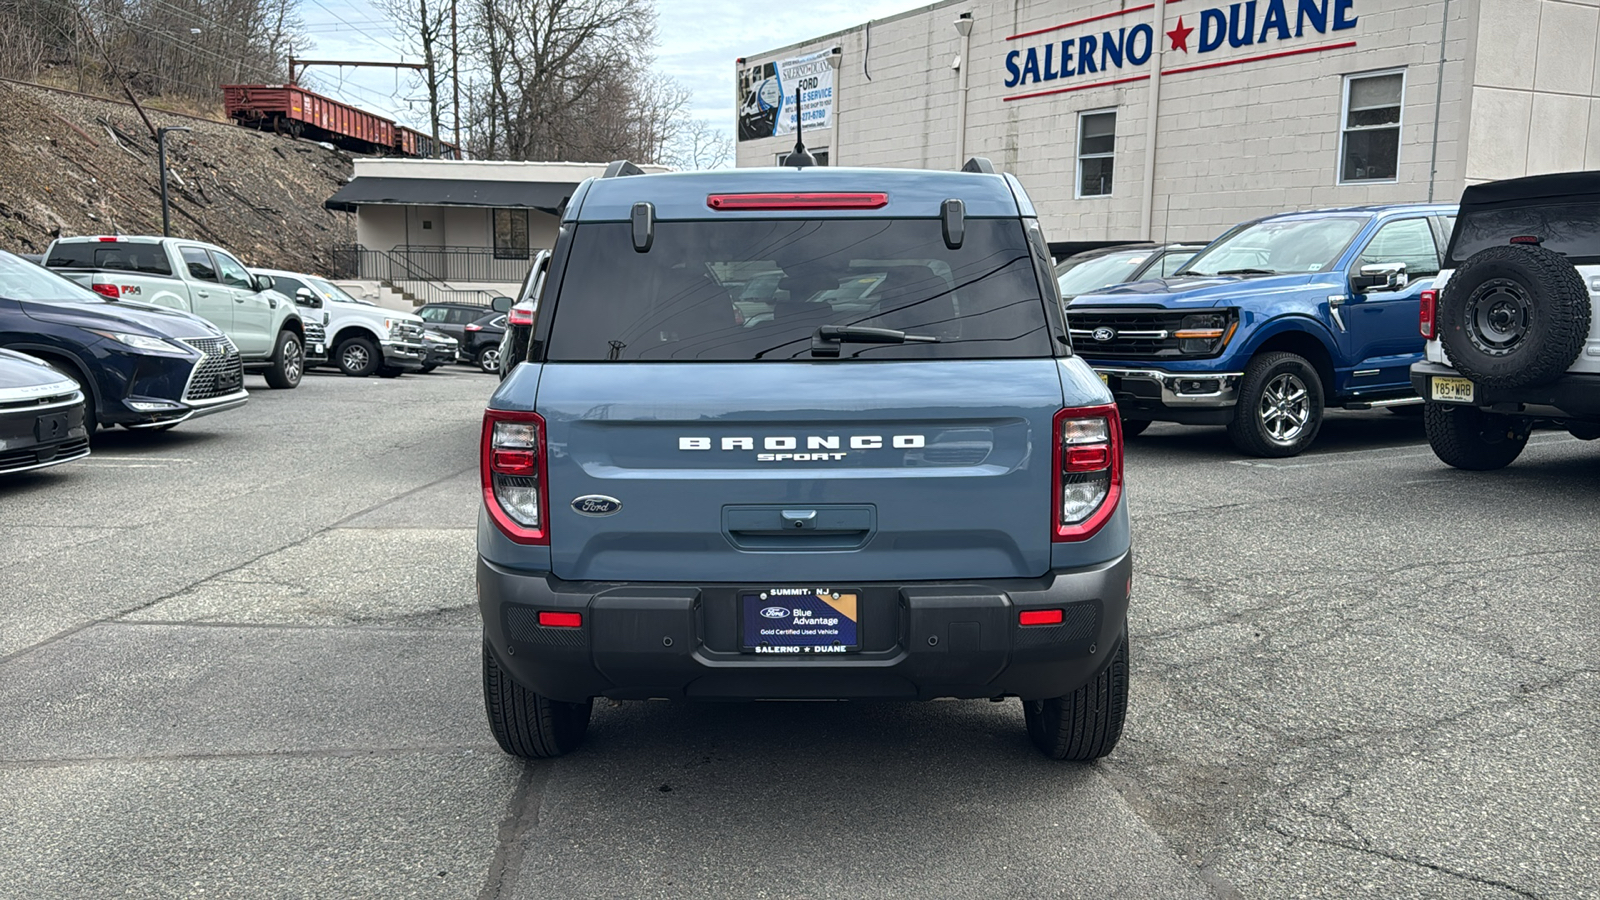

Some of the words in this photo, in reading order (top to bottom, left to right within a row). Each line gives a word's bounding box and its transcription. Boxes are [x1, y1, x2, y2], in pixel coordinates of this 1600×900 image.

[1004, 23, 1154, 88] SALERNO
[1198, 0, 1359, 54] DUANE
[798, 77, 818, 90] FORD
[785, 93, 807, 105] MOBLE
[807, 87, 832, 101] SERVICE
[121, 285, 141, 295] FX4
[678, 435, 926, 451] BRONCO
[757, 452, 847, 462] SPORT
[582, 498, 609, 511] Ford
[793, 608, 812, 617] Blue
[793, 617, 839, 626] Advantage
[755, 645, 801, 653] SALERNO
[814, 645, 847, 653] DUANE
